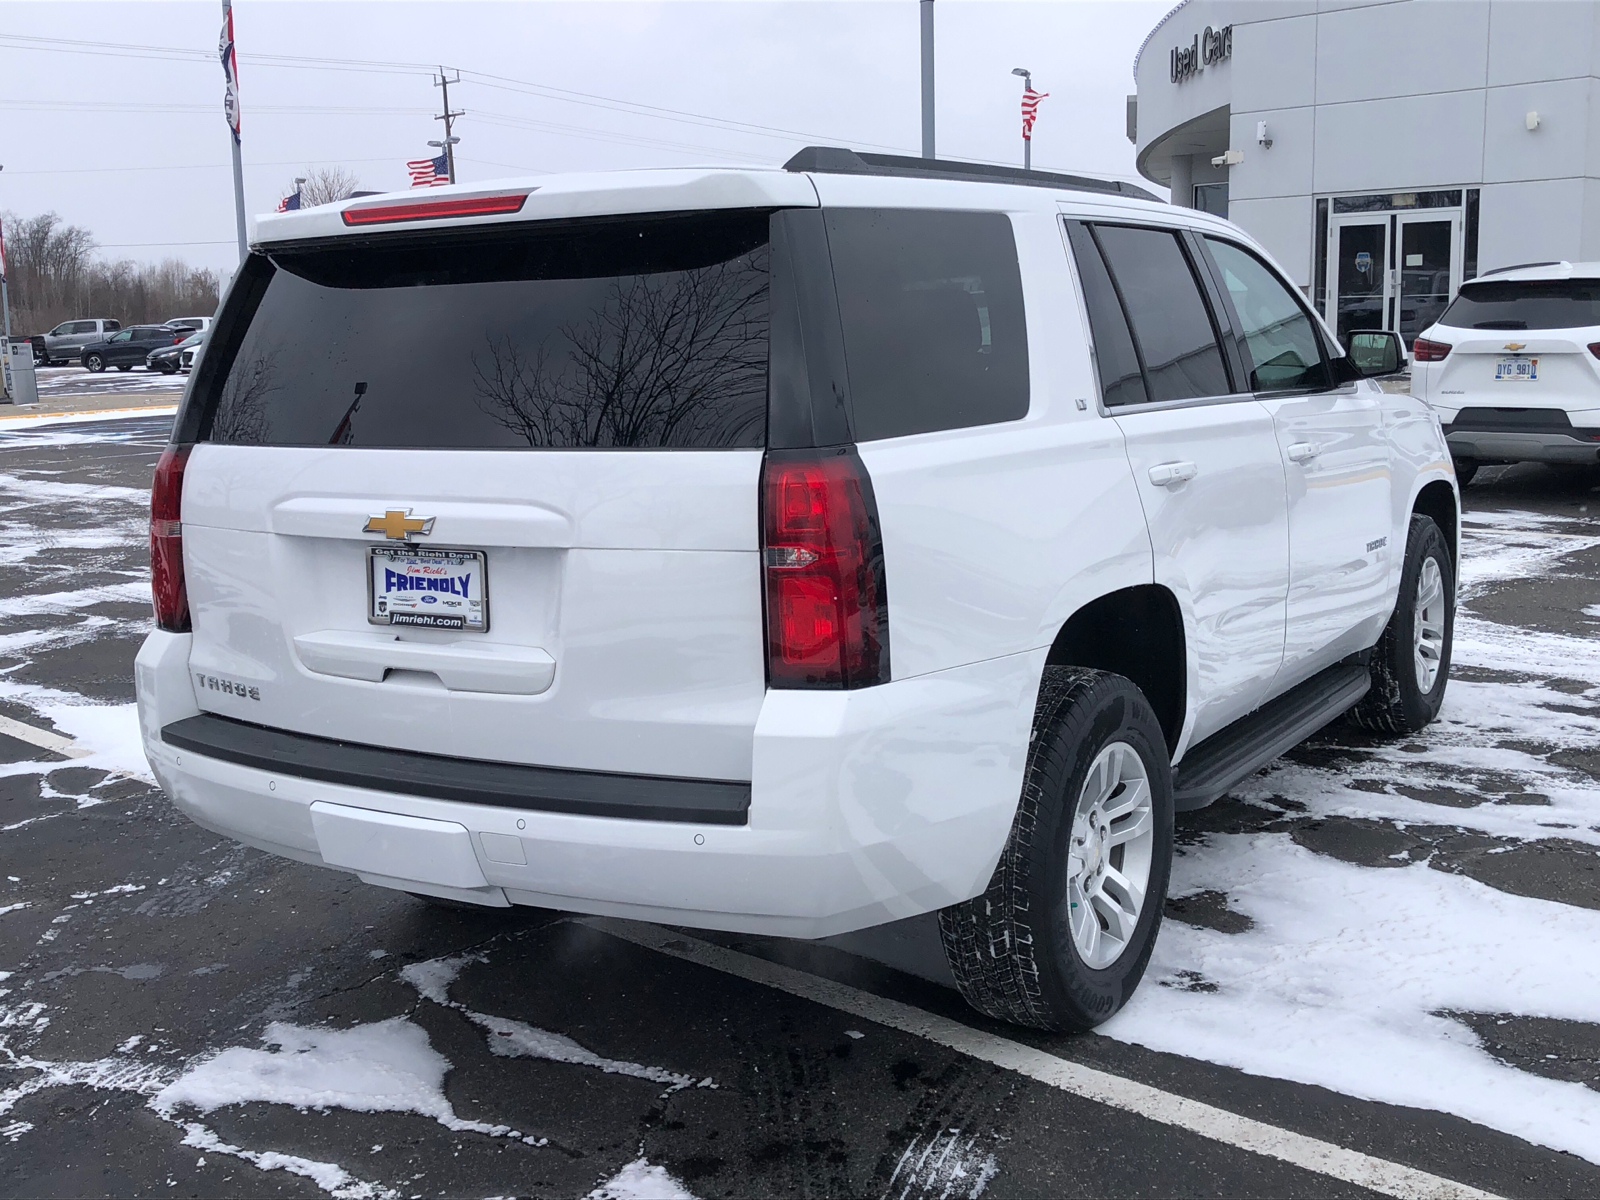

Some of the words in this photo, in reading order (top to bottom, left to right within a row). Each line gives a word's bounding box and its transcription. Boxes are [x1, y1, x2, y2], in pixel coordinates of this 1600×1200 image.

[1171, 34, 1198, 83] Used
[1202, 24, 1232, 66] Cars
[1497, 364, 1512, 375] DYG
[406, 565, 421, 575] Jim
[422, 566, 448, 575] Riehl's
[385, 567, 471, 599] FRIENDLY
[392, 614, 461, 627] jimriehl.com
[195, 672, 261, 702] TAHOE
